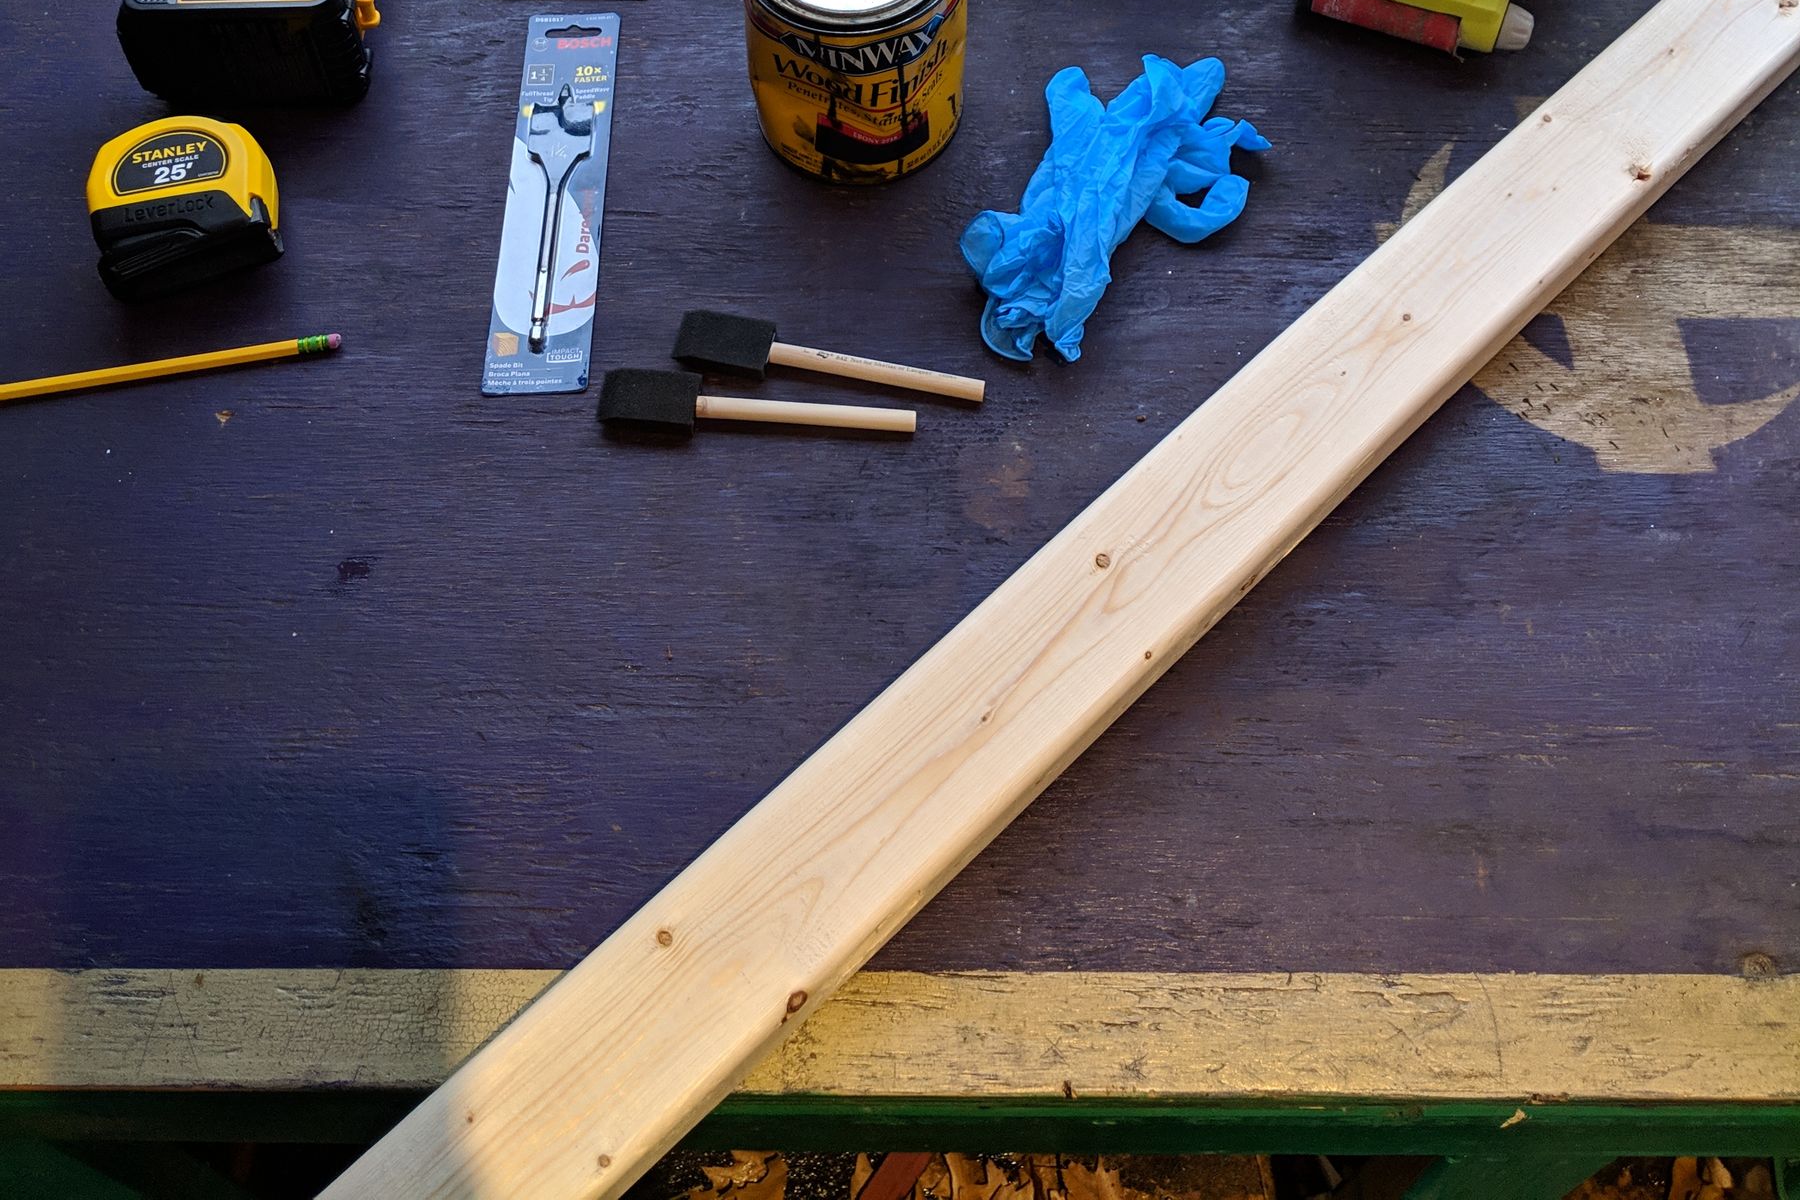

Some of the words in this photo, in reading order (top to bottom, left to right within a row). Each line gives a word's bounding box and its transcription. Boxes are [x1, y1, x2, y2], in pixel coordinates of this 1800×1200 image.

[556, 35, 613, 50] BOSCH
[574, 75, 608, 84] FASTER
[772, 51, 863, 106] Wood
[869, 38, 949, 108] Finish
[787, 80, 861, 114] Penetrtes,
[132, 140, 208, 164] STANLEY
[141, 158, 173, 169] CENTER
[174, 153, 200, 164] SCALE
[550, 353, 582, 361] TOUGH
